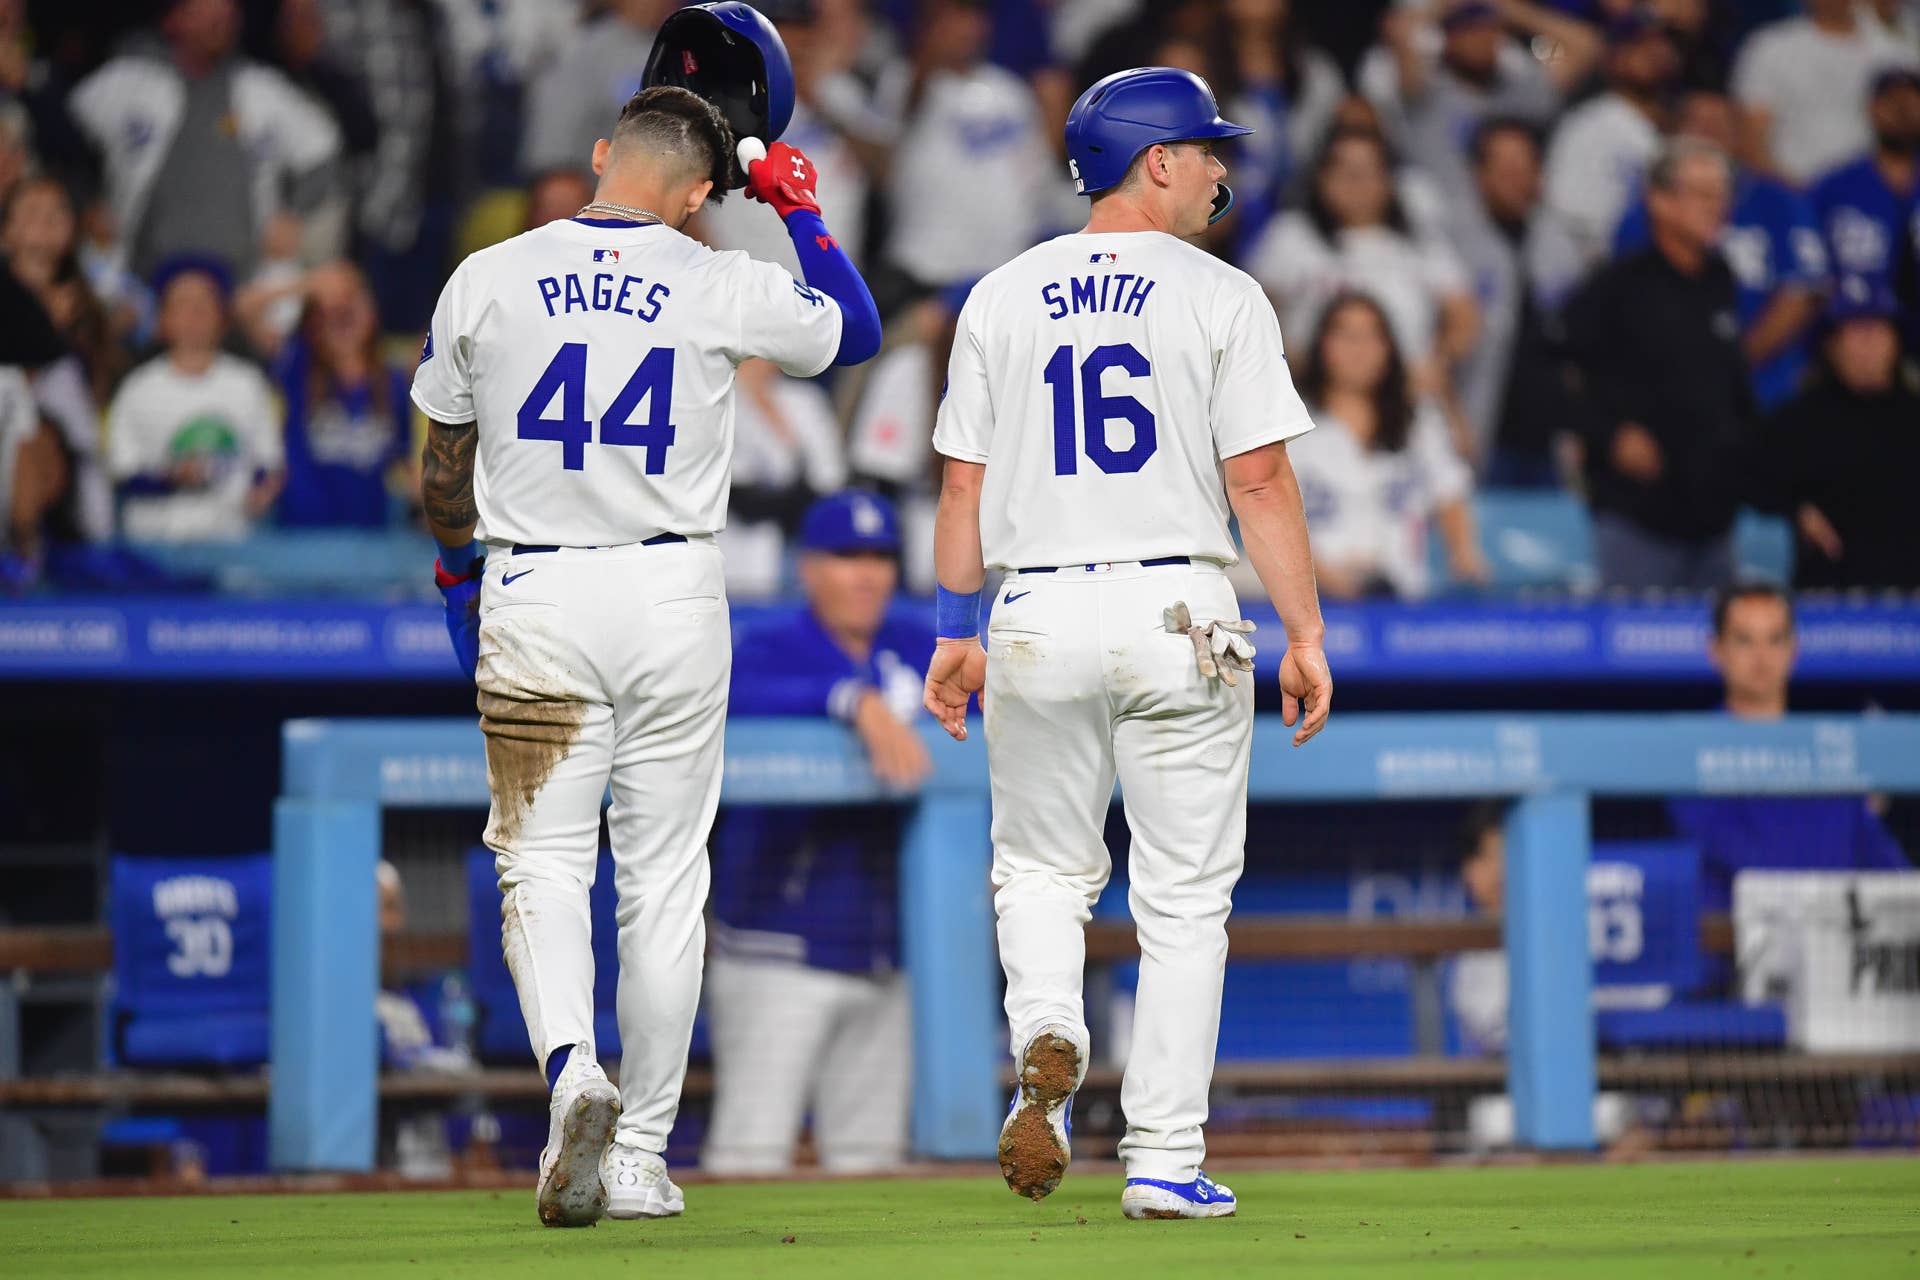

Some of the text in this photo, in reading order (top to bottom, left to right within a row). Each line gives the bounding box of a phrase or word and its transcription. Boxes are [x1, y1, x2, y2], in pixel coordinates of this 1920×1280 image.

[537, 273, 670, 323] PAGES
[1041, 274, 1156, 320] SMITH
[517, 342, 676, 475] 44
[1043, 342, 1158, 476] 16
